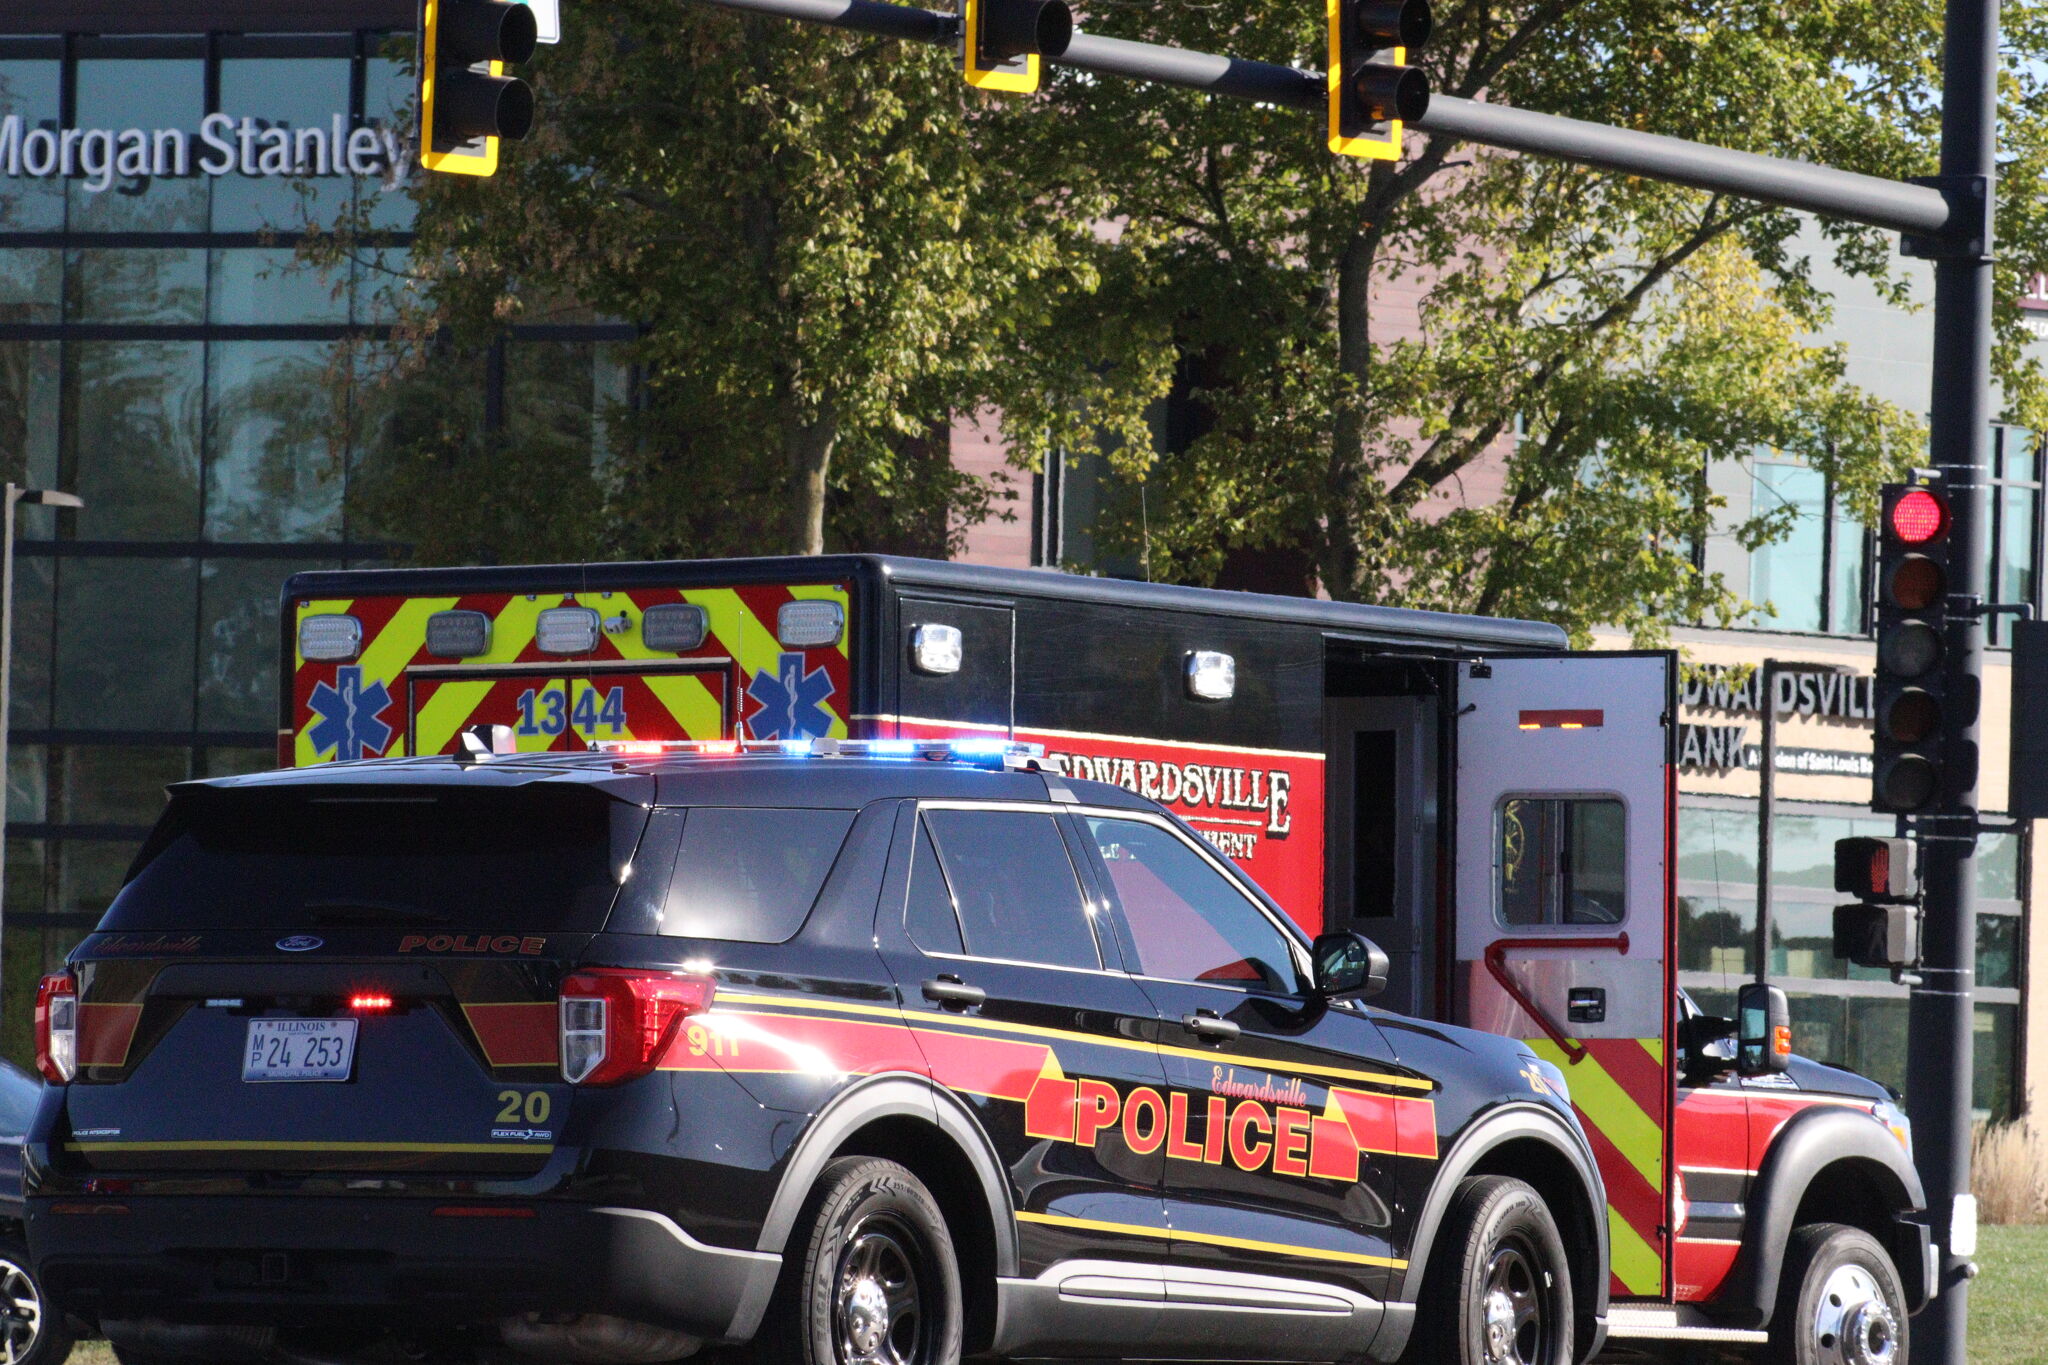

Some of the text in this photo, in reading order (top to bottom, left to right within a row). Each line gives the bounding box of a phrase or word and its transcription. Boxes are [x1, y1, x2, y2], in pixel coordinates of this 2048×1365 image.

[199, 112, 405, 192] Stanley
[516, 685, 627, 737] 1344
[1833, 755, 1860, 773] Louis
[398, 934, 547, 956] POLICE
[277, 1021, 326, 1032] ILLINOIS
[687, 1025, 740, 1057] 911
[266, 1037, 291, 1068] 24
[303, 1036, 344, 1068] 253
[1211, 1065, 1307, 1108] Edwardsville
[495, 1089, 551, 1124] 20
[1075, 1078, 1310, 1178] POLICE
